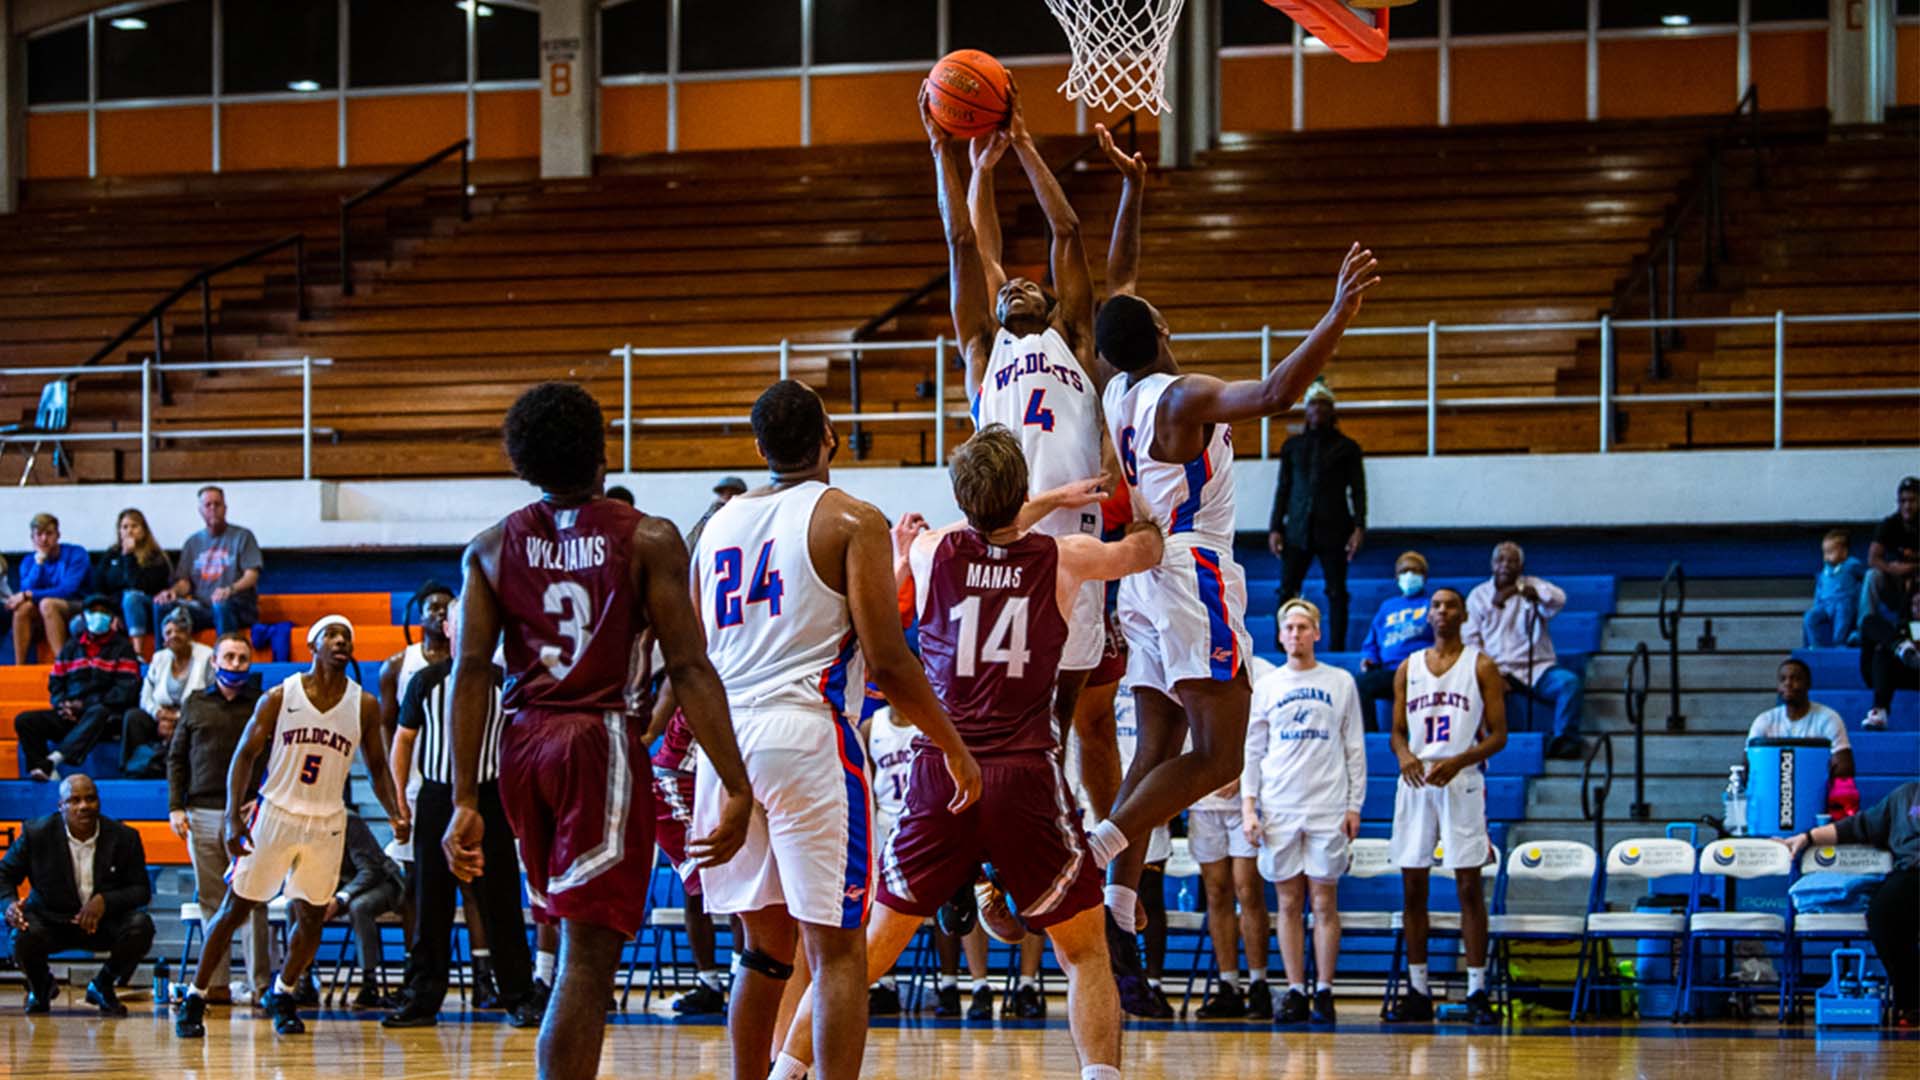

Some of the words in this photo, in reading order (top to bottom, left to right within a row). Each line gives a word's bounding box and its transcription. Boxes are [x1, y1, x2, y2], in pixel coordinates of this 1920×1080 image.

[549, 63, 571, 96] B
[1023, 388, 1055, 433] 4
[526, 535, 606, 572] WILLIAMS
[714, 537, 785, 630] 24
[965, 562, 1023, 589] MANAS
[539, 581, 592, 681] 3
[949, 595, 1031, 679] 14
[1407, 691, 1470, 713] WILDCATS
[282, 727, 352, 757] WILDCATS
[1424, 715, 1450, 744] 12
[300, 754, 322, 785] 5
[1780, 752, 1793, 827] POWERADE
